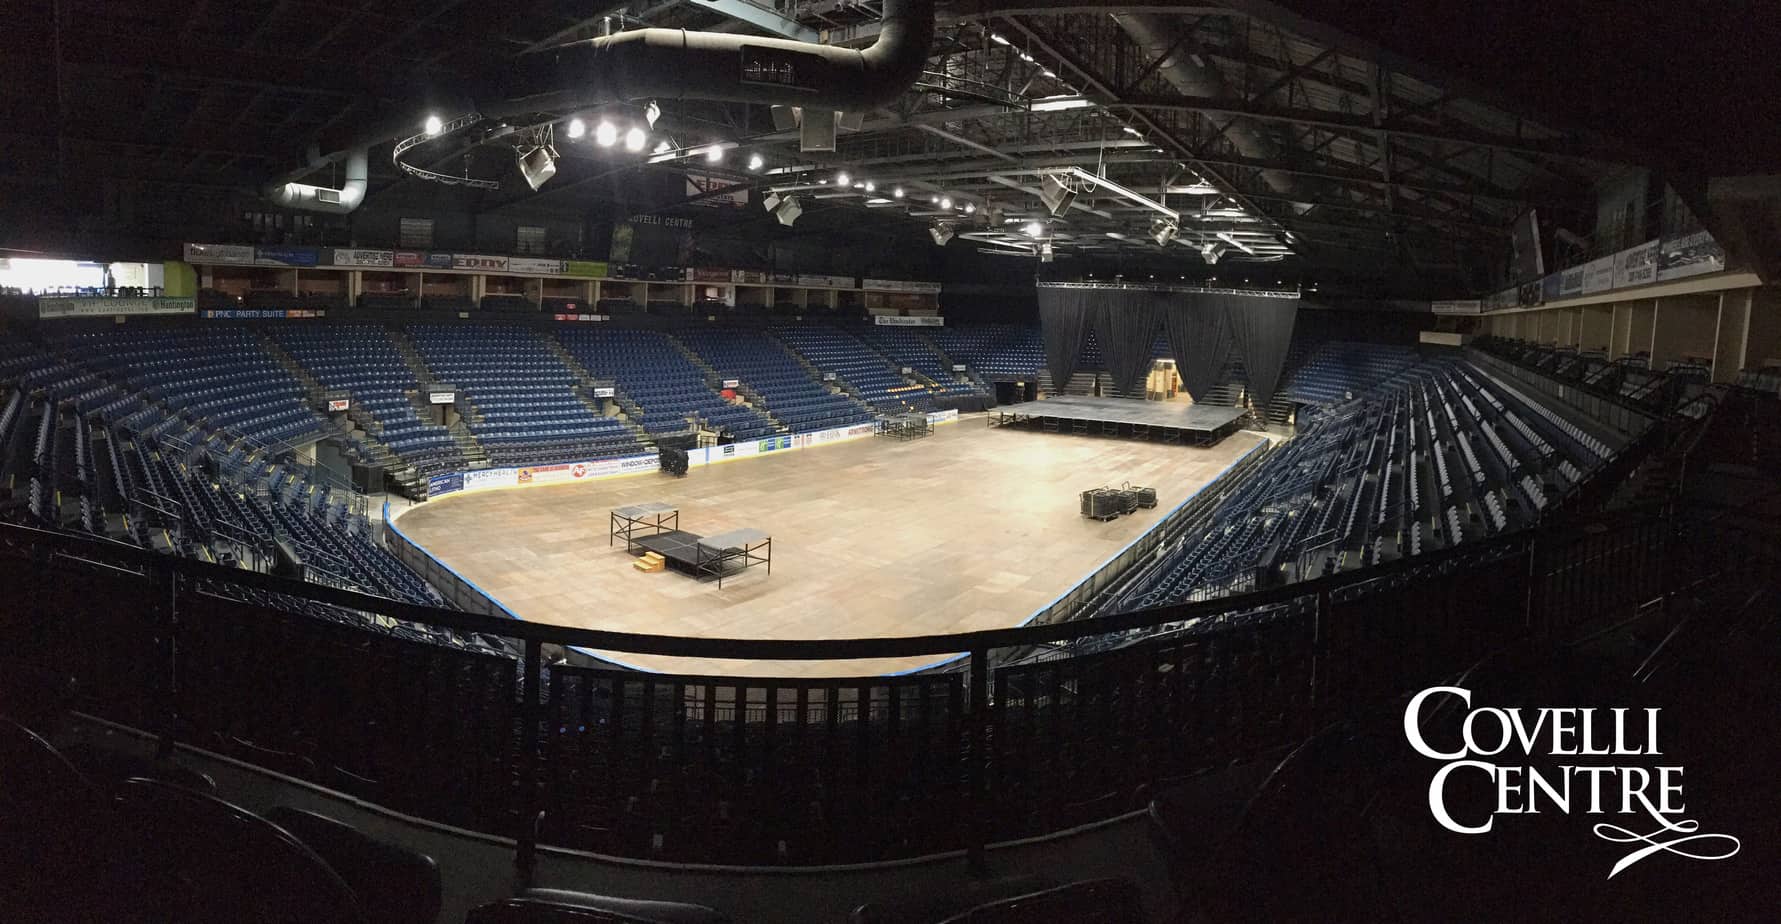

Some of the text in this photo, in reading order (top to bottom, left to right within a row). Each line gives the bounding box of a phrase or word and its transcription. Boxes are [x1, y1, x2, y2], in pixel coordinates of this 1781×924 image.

[629, 214, 661, 225] OVELLI
[161, 300, 194, 311] Huntington
[215, 310, 232, 318] PNC
[236, 310, 260, 318] PARTY
[262, 310, 284, 318] SUITE
